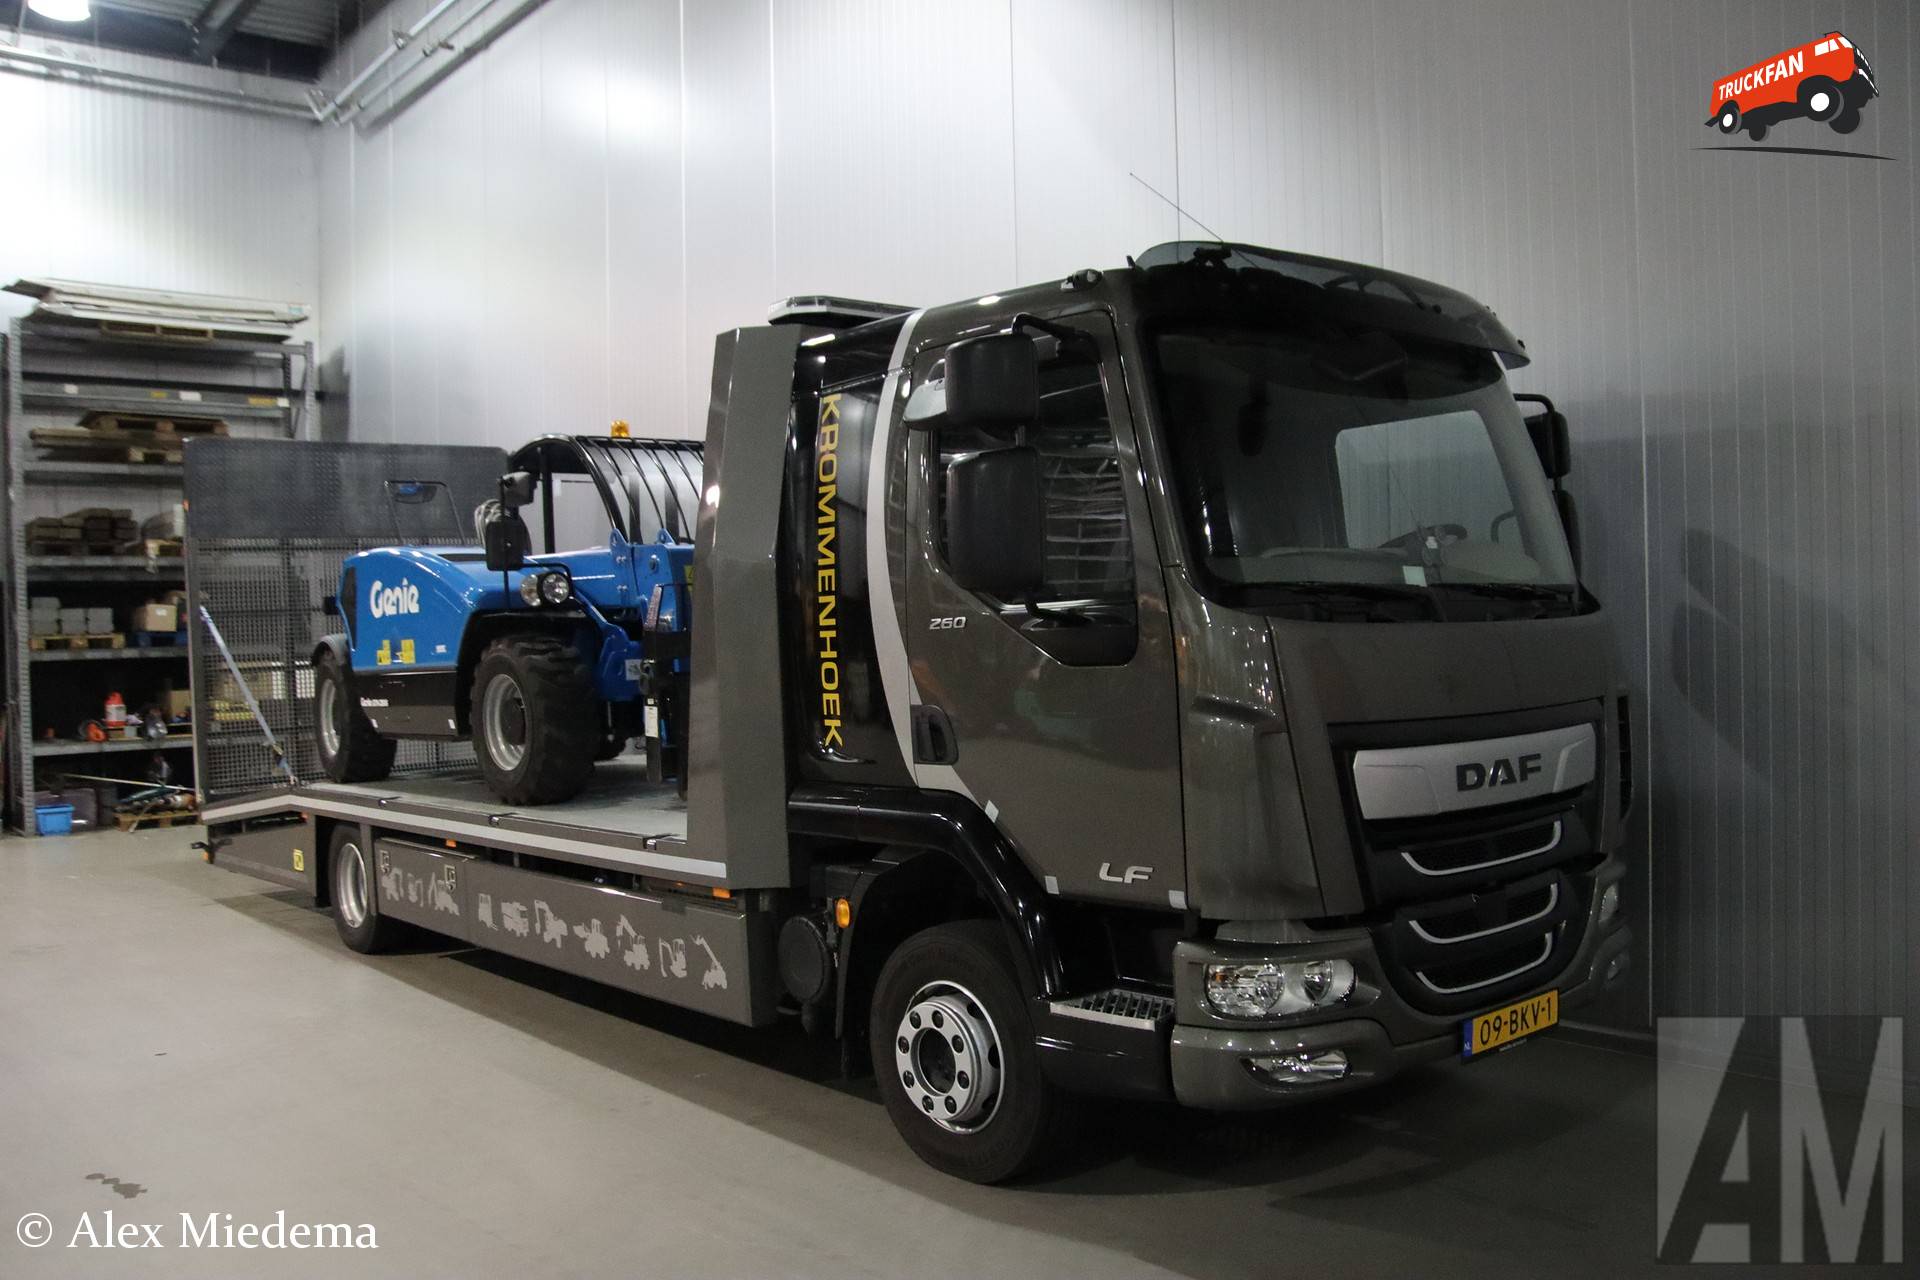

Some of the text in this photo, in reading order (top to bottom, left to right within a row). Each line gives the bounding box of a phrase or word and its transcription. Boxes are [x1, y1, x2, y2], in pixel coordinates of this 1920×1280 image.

[817, 393, 844, 748] KROMMENHOEK
[370, 577, 420, 618] Genie
[929, 616, 967, 630] 260
[1456, 753, 1542, 792] DAF
[1099, 862, 1154, 884] LF
[1480, 997, 1551, 1046] 09-BKV-1
